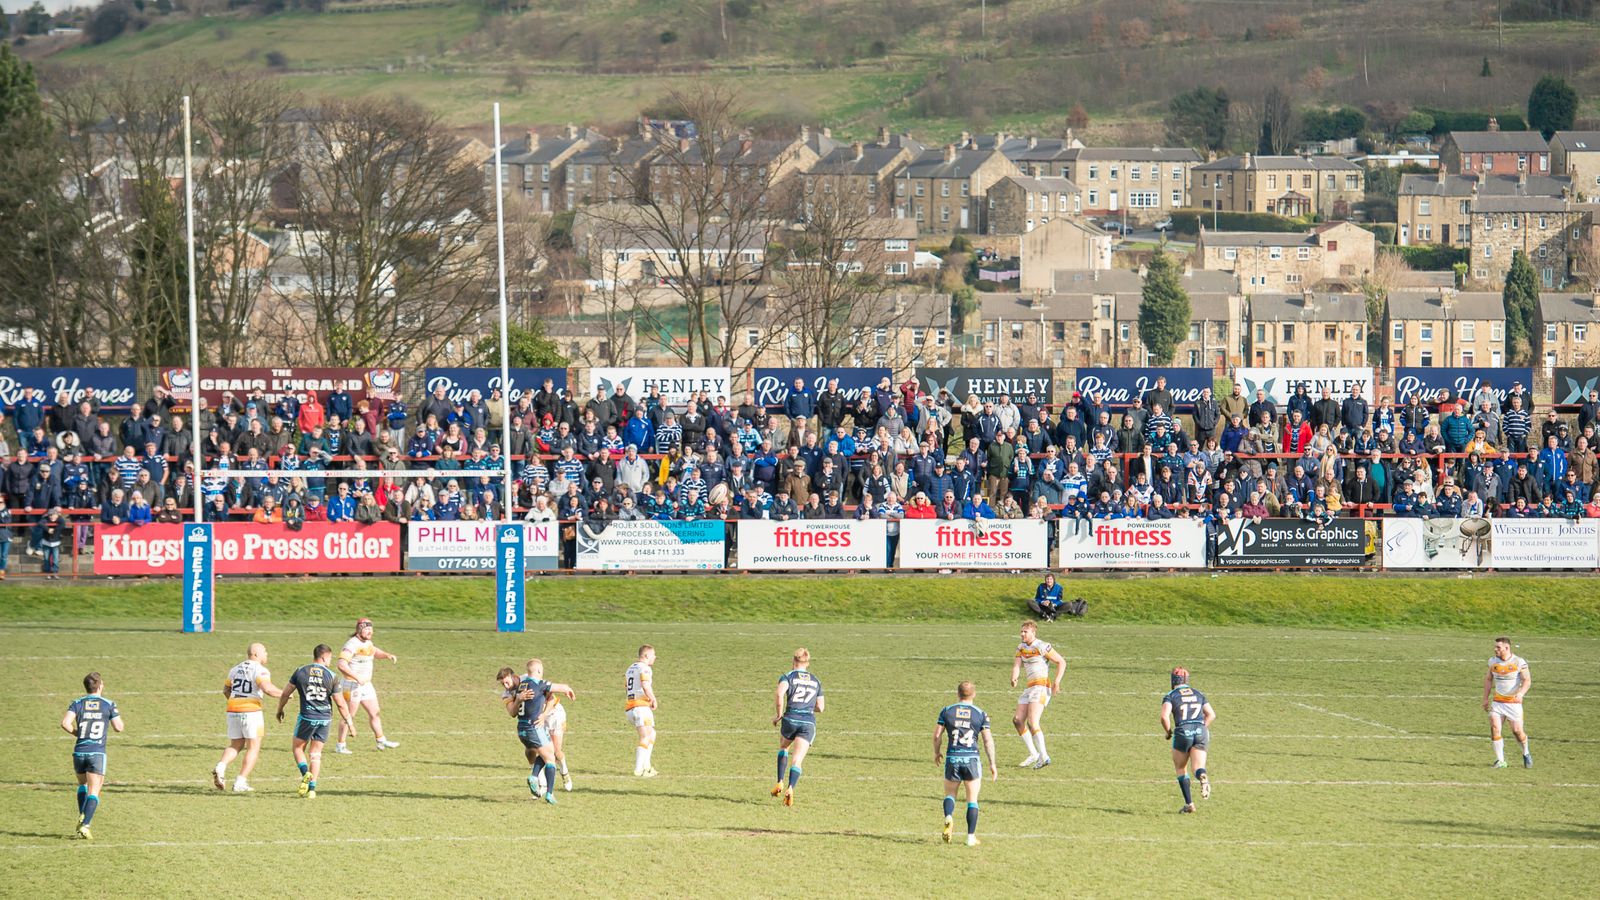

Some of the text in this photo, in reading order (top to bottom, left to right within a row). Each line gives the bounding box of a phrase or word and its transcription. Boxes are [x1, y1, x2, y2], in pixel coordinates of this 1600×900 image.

[51, 376, 134, 405] Homes
[200, 379, 267, 391] CRAIG
[643, 378, 725, 393] HENLEY
[967, 378, 1050, 394] HENLEY
[1078, 376, 1130, 402] Riva
[1286, 379, 1367, 394] HENLEY
[640, 521, 684, 529] SOLUTIONS
[685, 521, 714, 529] LIMITED
[1558, 524, 1596, 537] JOINERS
[418, 526, 467, 542] PHIL
[616, 530, 706, 538] PROCESS ENGINEERING
[774, 527, 852, 548] fitness
[936, 526, 1012, 547] fitness
[1095, 525, 1171, 546] fitness
[1261, 526, 1359, 543] Signs & Graphics
[101, 532, 393, 567] Kingsne Press Cider
[1074, 550, 1191, 560] powerhouse-fitness.co.uk
[438, 558, 478, 569] 07740
[753, 554, 871, 564] powerhouse-fitness.co.uk
[192, 546, 205, 625] BETFRED
[505, 547, 517, 625] BETFRED
[233, 678, 253, 694] 20
[628, 677, 635, 691] 9
[793, 686, 817, 704] 27
[1180, 703, 1202, 721] 17
[79, 721, 105, 740] 19
[952, 729, 975, 748] 14
